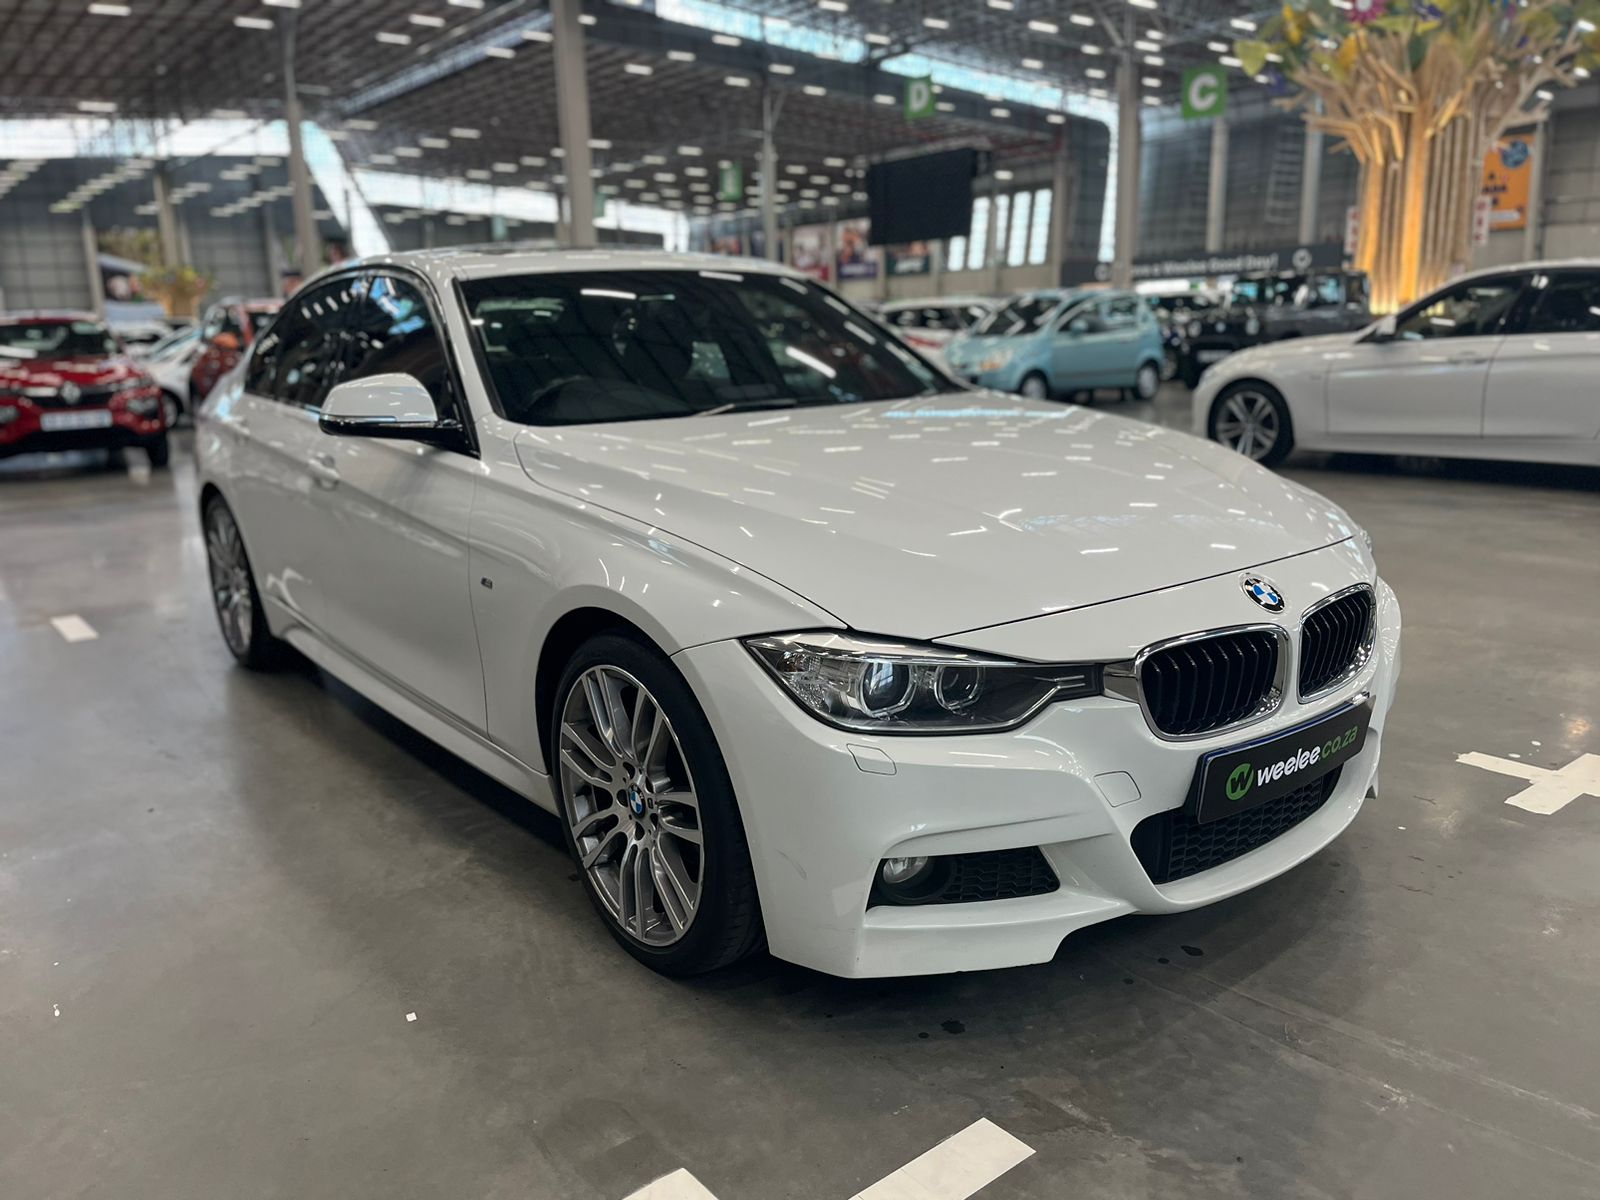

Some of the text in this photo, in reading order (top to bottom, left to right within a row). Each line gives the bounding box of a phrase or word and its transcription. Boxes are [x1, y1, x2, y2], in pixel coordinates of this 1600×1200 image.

[909, 81, 929, 112] D
[1189, 73, 1218, 111] C
[1257, 725, 1358, 787] weelee.co.za
